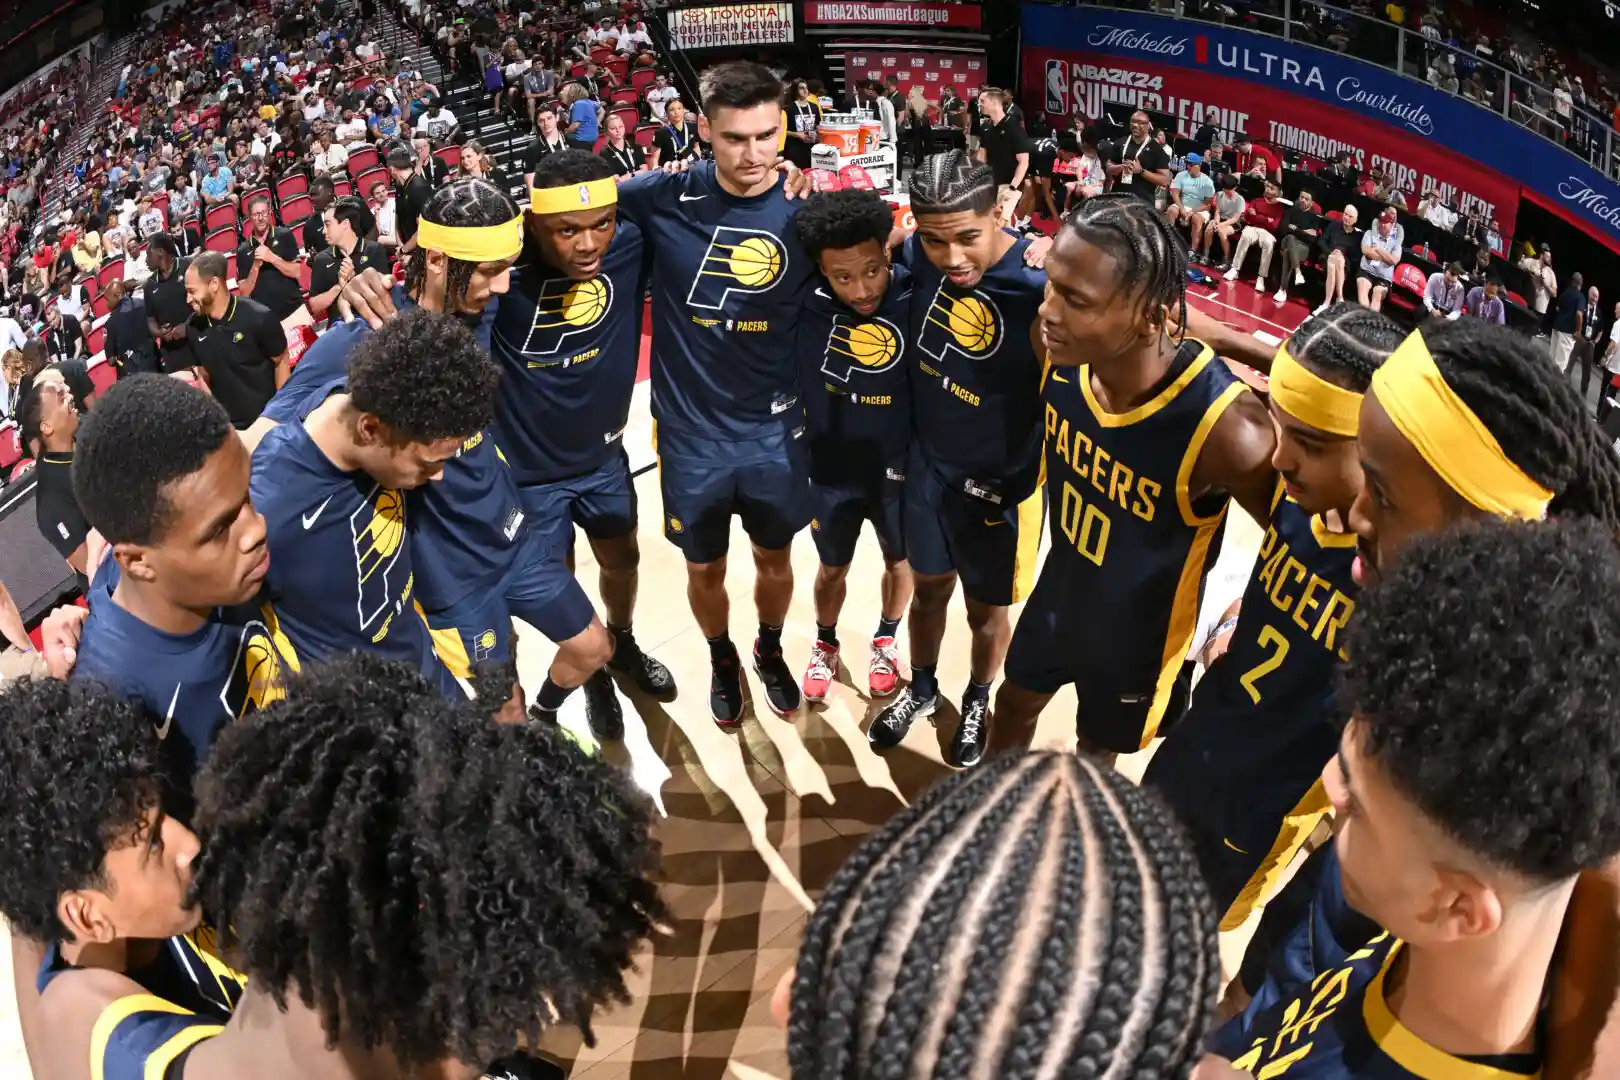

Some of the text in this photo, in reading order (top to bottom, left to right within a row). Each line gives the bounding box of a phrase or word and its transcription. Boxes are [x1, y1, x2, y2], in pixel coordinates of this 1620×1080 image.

[712, 7, 777, 19] TOYOTA
[817, 3, 949, 25] #NBA2KSummerLeague
[671, 20, 792, 36] SOUTHERN NEVADA
[682, 30, 786, 45] TOYOTA DEALERS
[1072, 63, 1164, 91] NBA2K24
[1087, 24, 1435, 136] Michelob ULTRA Courtside
[850, 154, 885, 166] GATORADE
[736, 320, 768, 332] PACERS
[860, 395, 892, 405] PACERS
[950, 382, 980, 407] PACERS
[1045, 401, 1162, 522] PACERS
[1060, 480, 1111, 567] 00
[1259, 523, 1356, 661] PACER
[1239, 624, 1290, 706] 2
